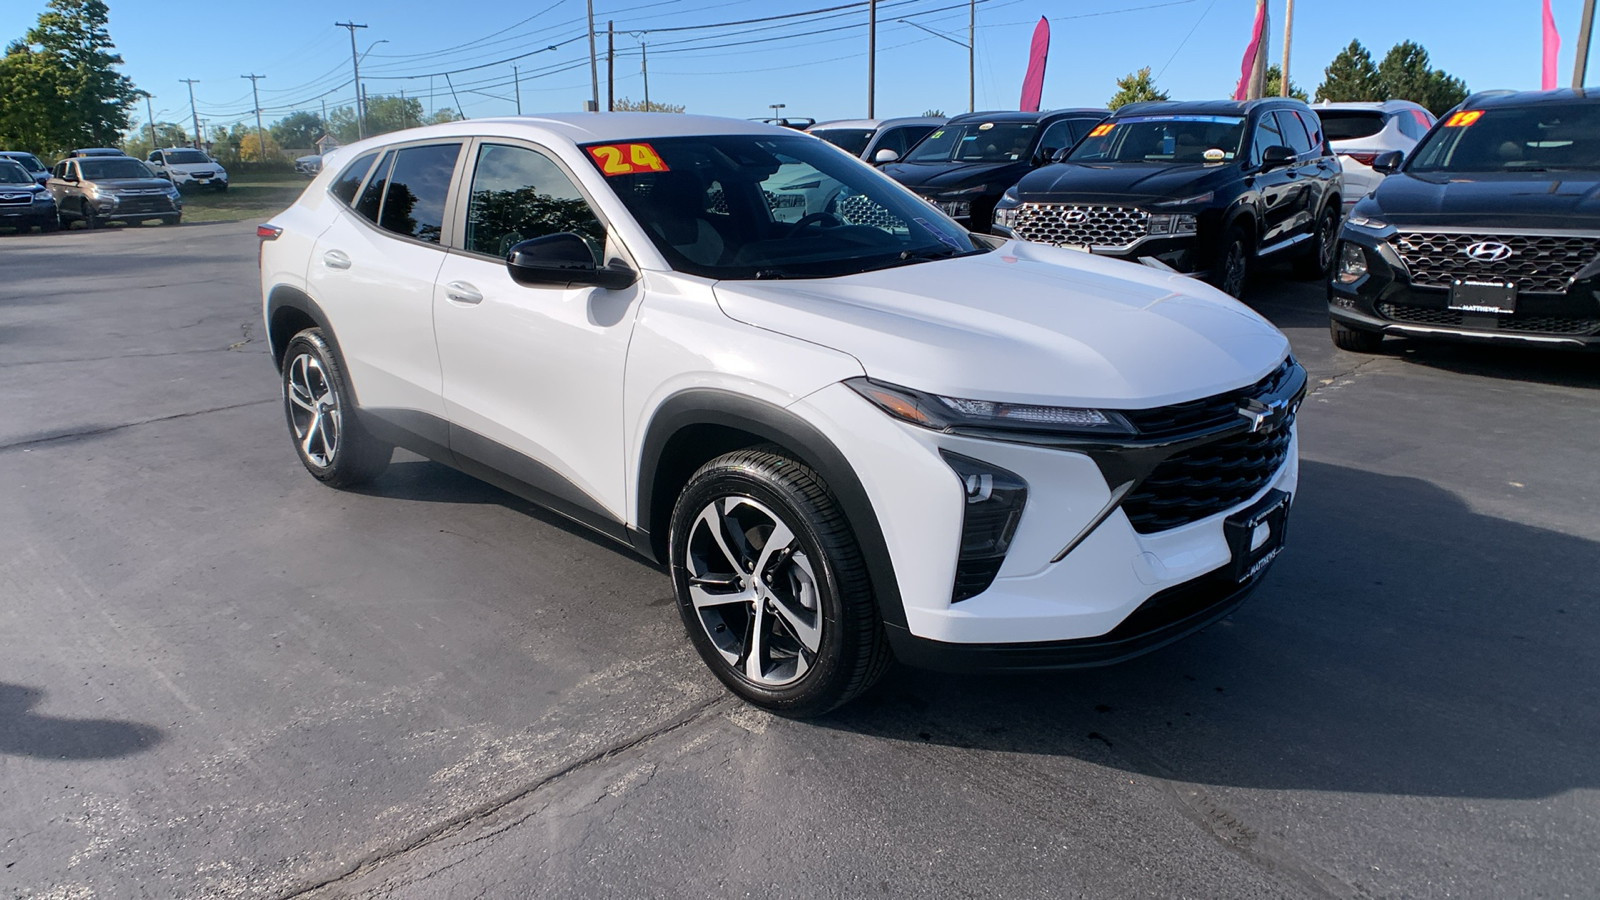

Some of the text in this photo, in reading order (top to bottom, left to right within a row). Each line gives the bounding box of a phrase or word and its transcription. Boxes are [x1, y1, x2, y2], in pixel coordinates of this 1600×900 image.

[1448, 110, 1480, 126] 19
[592, 144, 663, 174] 24
[1462, 304, 1500, 314] MATTHEWS
[1250, 548, 1278, 575] MATTHEWS
